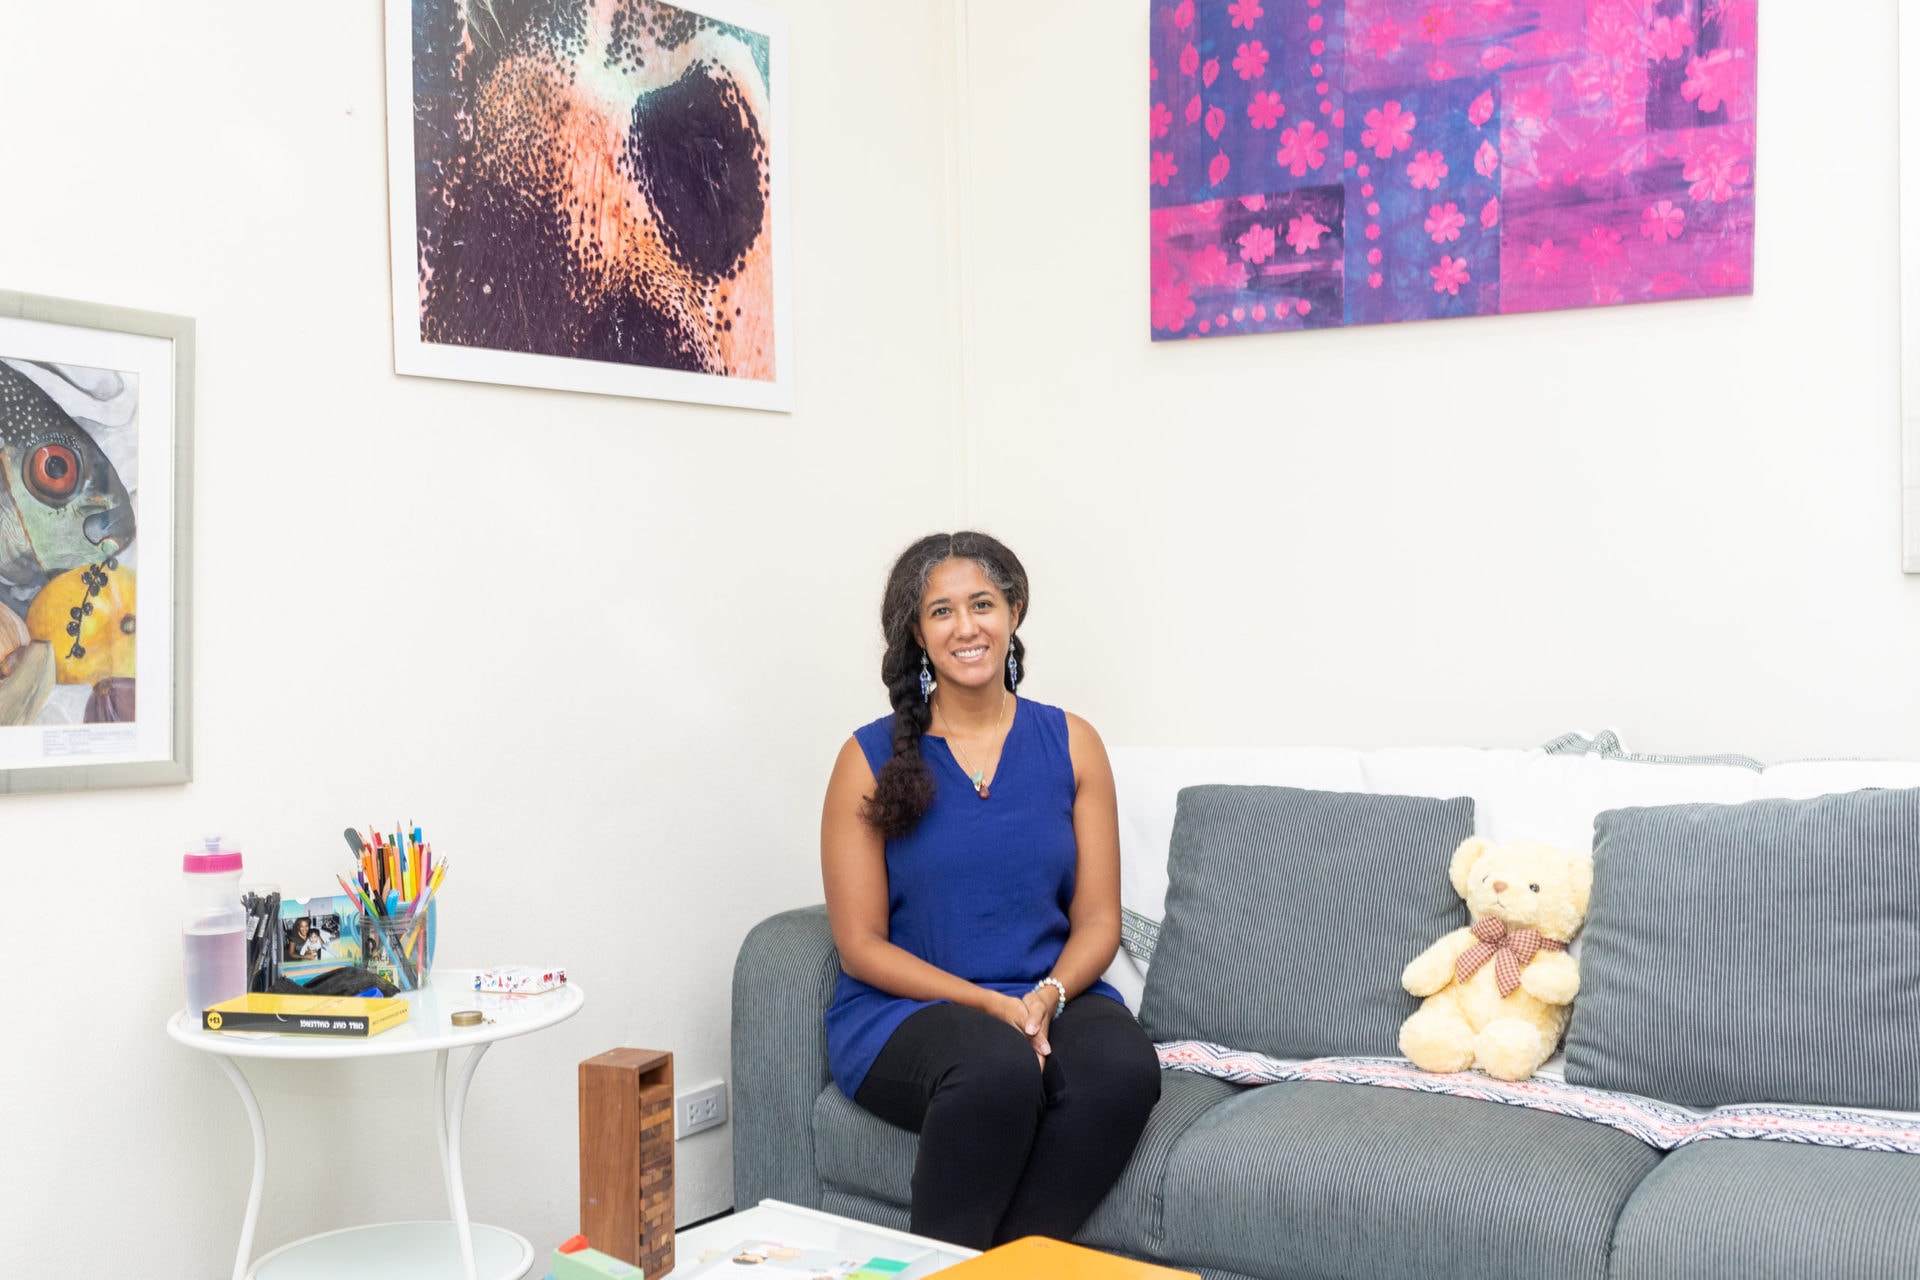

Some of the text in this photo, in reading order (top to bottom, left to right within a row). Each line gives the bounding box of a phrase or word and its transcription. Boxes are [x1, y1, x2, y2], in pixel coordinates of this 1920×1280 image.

[299, 1019, 364, 1030] CHILL CHAT CHALLENGE
